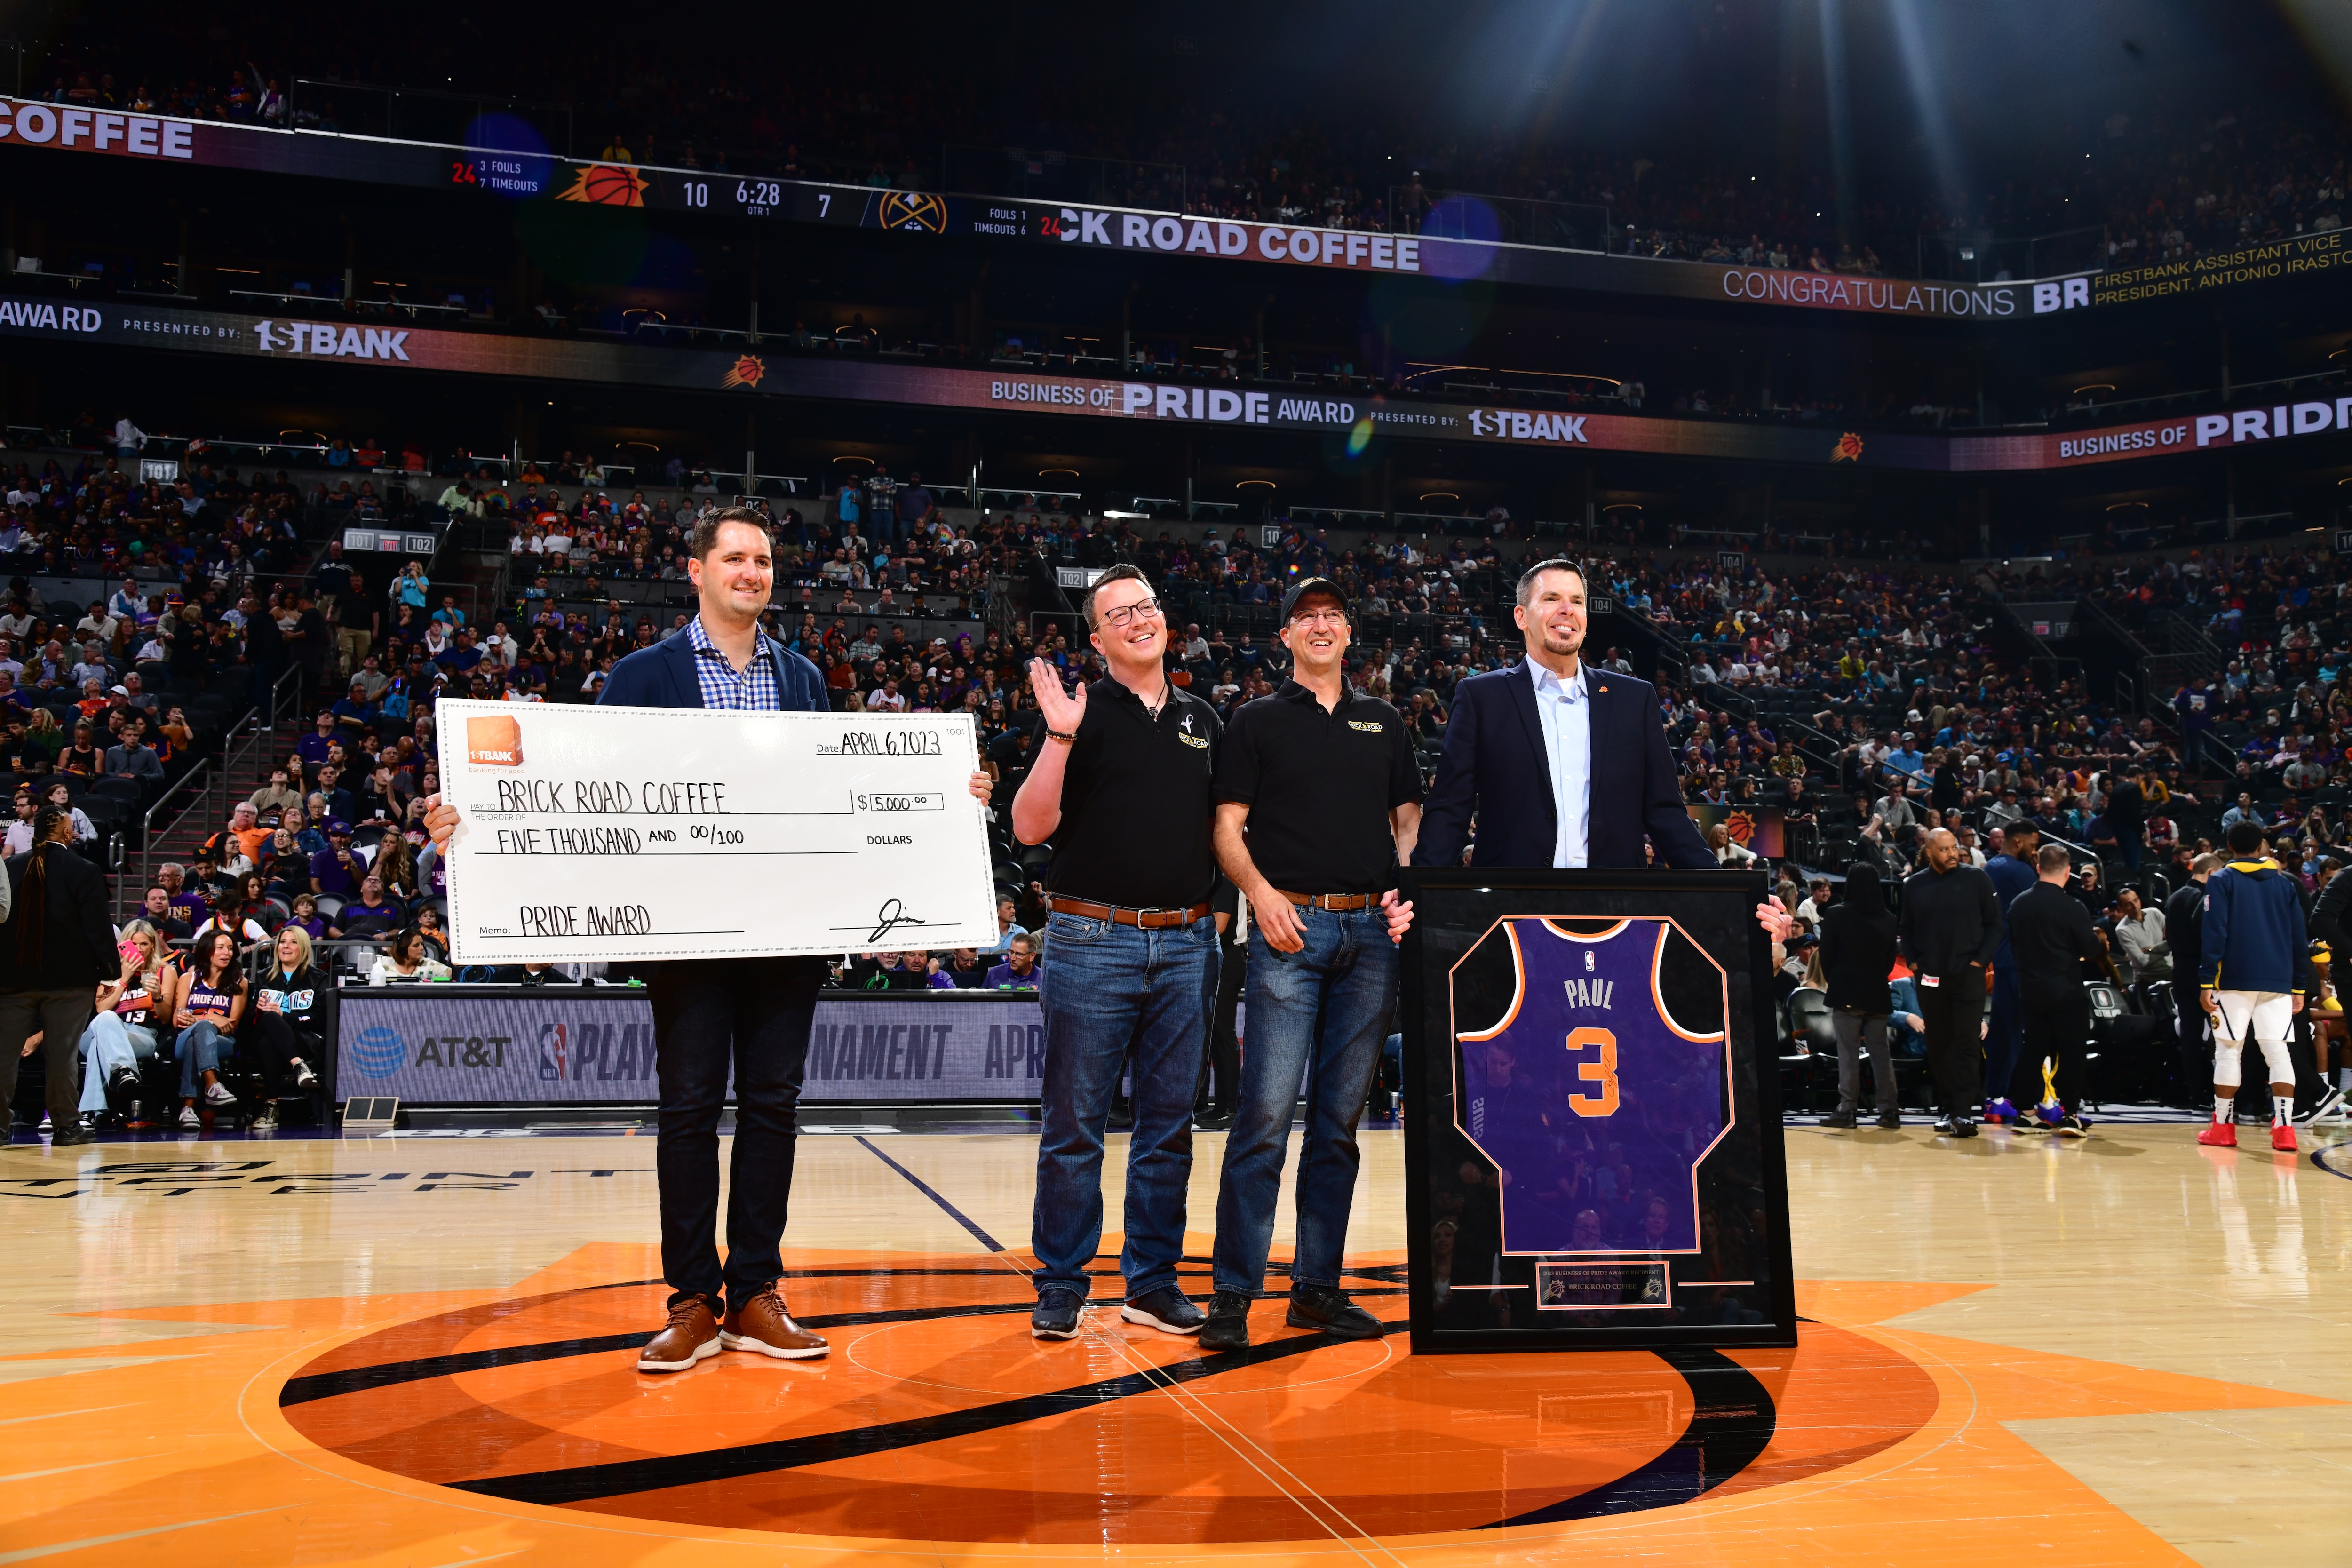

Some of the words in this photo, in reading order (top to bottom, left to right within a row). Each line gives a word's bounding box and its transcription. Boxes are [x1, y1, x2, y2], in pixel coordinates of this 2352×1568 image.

[453, 163, 476, 183] 24
[480, 161, 486, 171] 3
[492, 161, 521, 174] FOULS
[480, 178, 486, 188] 7
[492, 178, 538, 192] TIMEOUTS
[684, 182, 708, 207] 10
[736, 181, 779, 206] 6:28
[747, 206, 763, 215] QTR
[765, 207, 769, 216] 1
[819, 194, 831, 218] 7
[990, 208, 1016, 220] FOULS
[1022, 210, 1025, 220] 1
[974, 222, 1016, 235] TIMEOUTS
[1021, 225, 1026, 235] 6
[1041, 217, 1061, 236] 24
[1123, 215, 1248, 255] ROAD
[1259, 228, 1419, 271] COFFEE
[2094, 262, 2191, 289] FIRSTBANK
[2193, 243, 2292, 271] ASSISTANT
[2298, 233, 2341, 255] VICE
[1723, 270, 2015, 315] CONGRATULATIONS
[2033, 277, 2089, 314] BR
[2095, 277, 2194, 306] PRESIDENT,
[2199, 263, 2281, 289] ANTONIO
[0, 301, 102, 332] AWARD
[124, 319, 210, 336] PRESENTED
[218, 324, 240, 339] BY:
[254, 320, 410, 361] 1STBANK
[992, 381, 1085, 405] BUSINESS
[1090, 389, 1114, 407] OF
[1123, 383, 1269, 424] PRIDE
[1277, 399, 1354, 424] AWARD
[1370, 412, 1436, 426] PRESENTED
[1441, 416, 1459, 427] BY:
[1468, 409, 1588, 442] 1STBANK
[2060, 430, 2156, 457] BUSINESS
[2161, 425, 2186, 445] OF
[147, 463, 171, 479] 101
[351, 535, 368, 548] 101
[382, 540, 397, 551] EXIT
[412, 539, 429, 551] 102
[1266, 530, 1282, 544] 10
[1722, 556, 1740, 569] 104
[1063, 573, 1080, 585] 102
[1594, 600, 1608, 611] 104
[842, 732, 885, 755] APRIL
[470, 750, 513, 762] 1STBANK
[498, 780, 565, 812] BRICK
[575, 781, 633, 813] ROAD
[643, 781, 731, 814] COFFEE
[858, 794, 868, 811] $
[497, 829, 542, 854] FIVE
[546, 827, 641, 855] THOUSAND
[649, 830, 676, 842] AND
[690, 823, 744, 845] 00/100
[866, 835, 912, 845] DOLLARS
[520, 906, 580, 936] PRIDE
[587, 905, 651, 935] AWARD
[1564, 978, 1613, 1010] PAUL
[125, 1011, 146, 1023] 13
[415, 1037, 512, 1068] AT&T
[803, 1024, 953, 1080] NAMENT
[1566, 1027, 1620, 1118] 3
